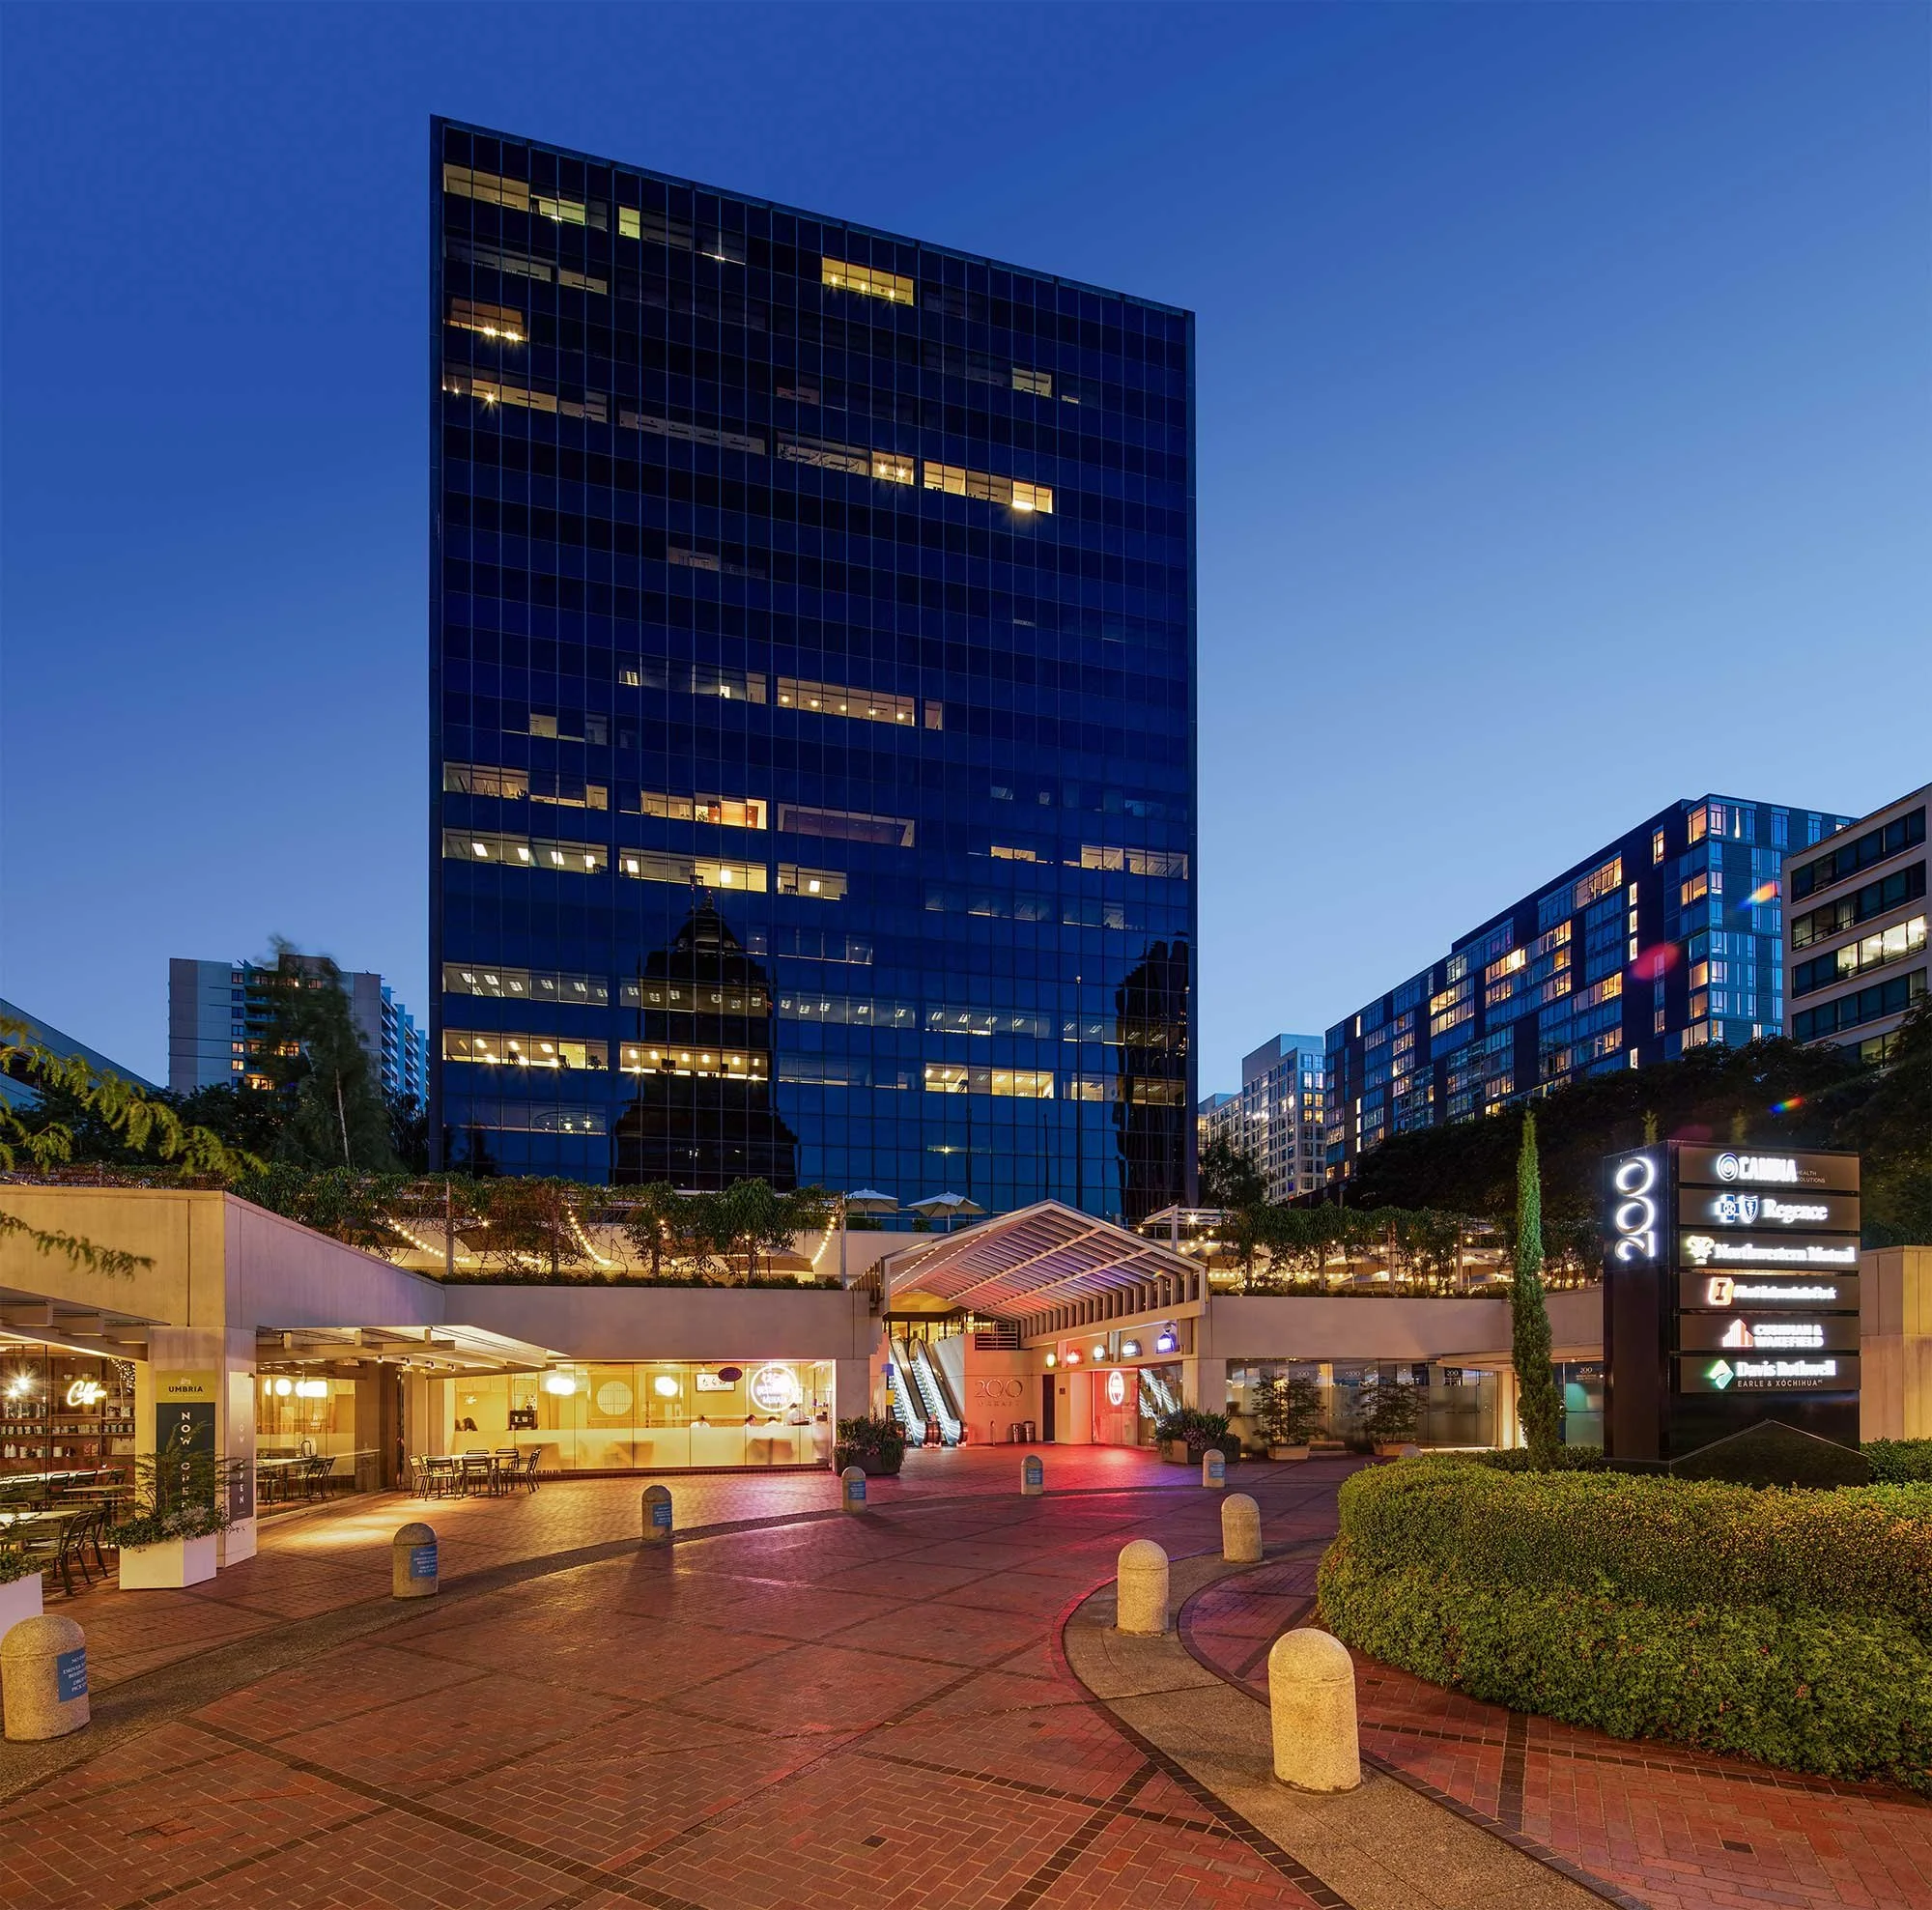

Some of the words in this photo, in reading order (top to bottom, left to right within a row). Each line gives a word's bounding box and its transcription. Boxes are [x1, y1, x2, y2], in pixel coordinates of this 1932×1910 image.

[1762, 1199, 1828, 1223] Regence
[1736, 1360, 1776, 1377] Davis
[974, 1379, 1023, 1398] 200
[180, 1411, 192, 1445] NOW
